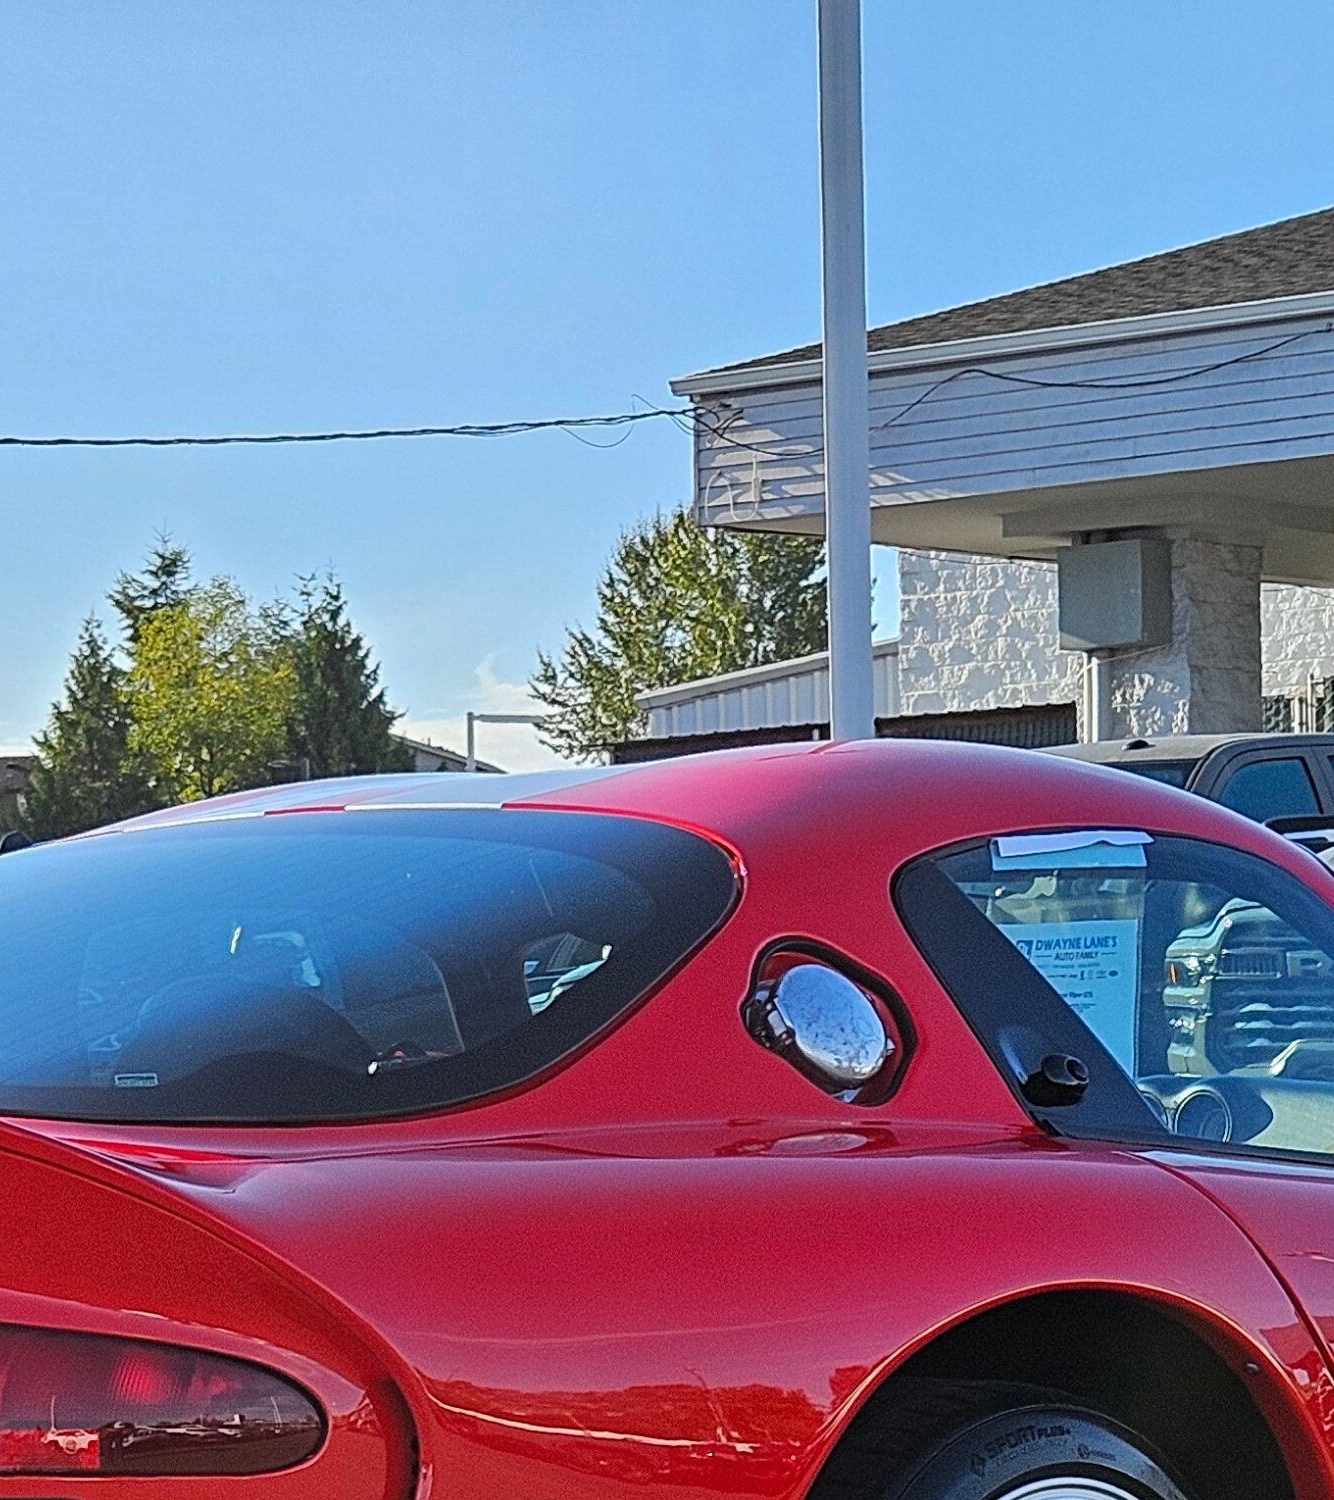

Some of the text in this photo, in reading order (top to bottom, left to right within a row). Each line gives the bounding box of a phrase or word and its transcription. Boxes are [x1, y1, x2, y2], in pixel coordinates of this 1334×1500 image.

[1034, 938, 1082, 951] DWAYNE
[1054, 950, 1099, 961] AUTO FAMILY
